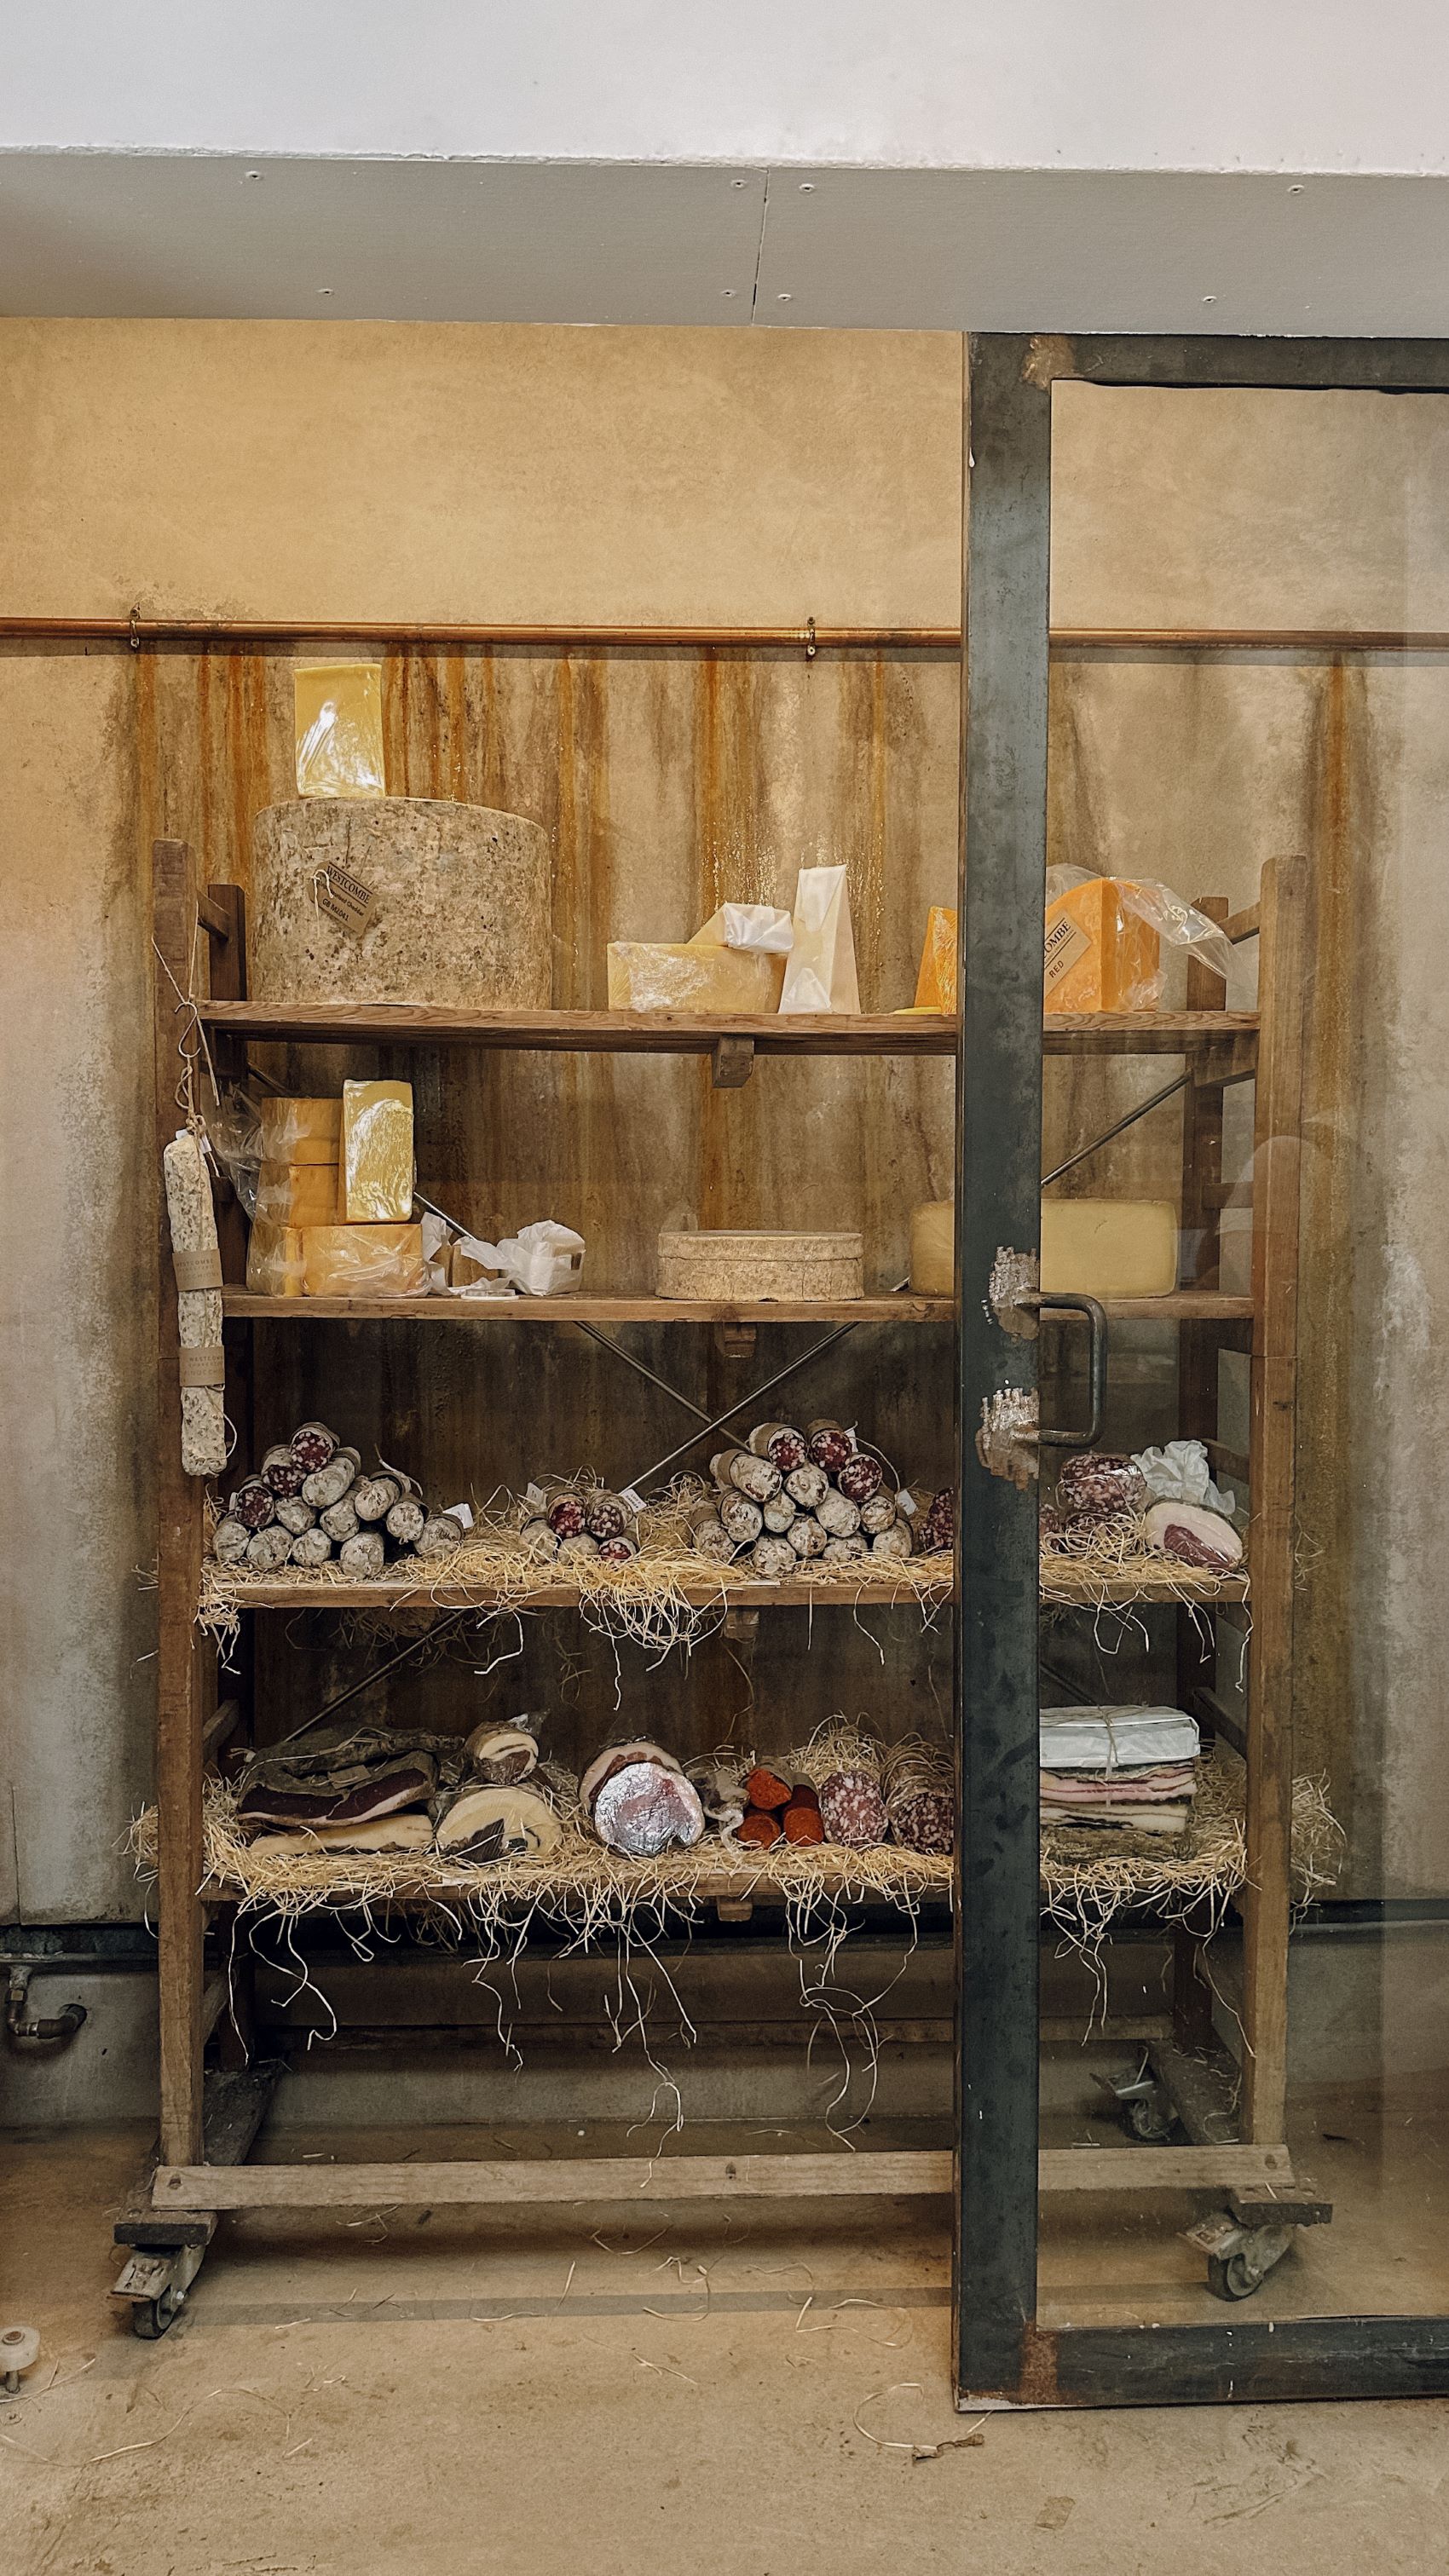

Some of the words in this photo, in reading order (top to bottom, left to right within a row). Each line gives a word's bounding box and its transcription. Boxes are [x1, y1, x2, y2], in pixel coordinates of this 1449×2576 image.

[326, 865, 369, 904] WESTCOMBE
[1044, 921, 1071, 958] OMBE
[1048, 960, 1064, 978] RED
